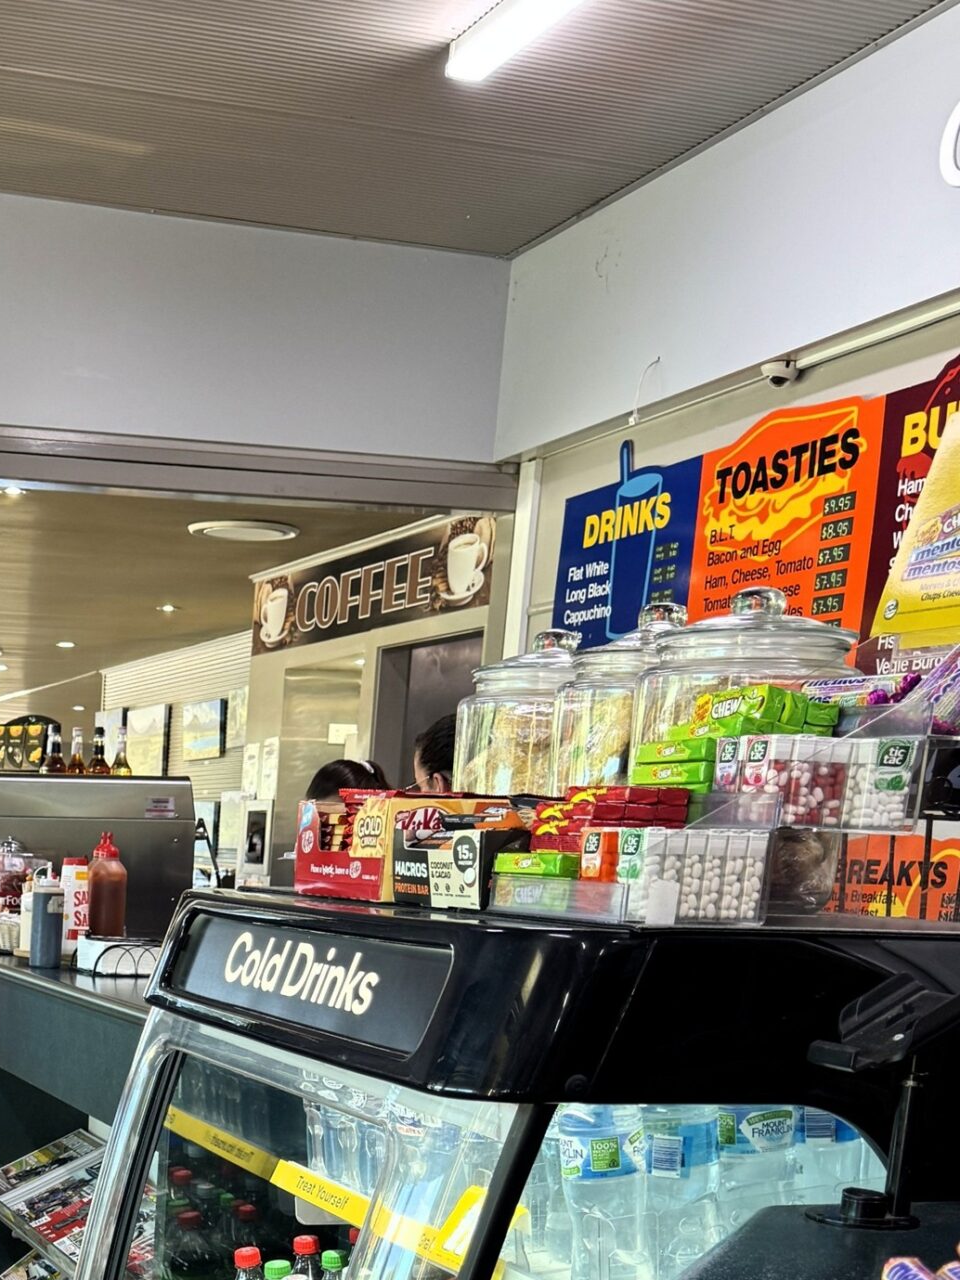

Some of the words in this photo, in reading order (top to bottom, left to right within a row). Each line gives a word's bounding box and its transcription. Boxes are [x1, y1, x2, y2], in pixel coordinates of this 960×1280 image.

[717, 428, 860, 503] TOASTIES
[824, 496, 851, 514] $9.95
[583, 492, 672, 549] DRINKS
[822, 519, 848, 539] $8.95
[707, 550, 738, 567] Bacon
[740, 545, 758, 560] and
[761, 538, 782, 557] Egg
[818, 547, 844, 566] $7.95
[568, 566, 583, 583] Flat
[585, 561, 609, 579] White
[705, 575, 728, 591] Ham,
[731, 565, 771, 584] Cheese,
[775, 556, 814, 576] Tomato
[295, 546, 435, 632] COFFEE
[815, 572, 843, 591] $7.95
[565, 588, 586, 604] Long
[588, 580, 612, 598] Black
[704, 594, 732, 612] Tomat
[812, 597, 839, 615] $7.95
[564, 604, 612, 626] Cappuchino
[711, 695, 744, 720] CHEW
[725, 742, 736, 752] tic
[754, 742, 767, 752] tic
[888, 746, 905, 757] tic
[721, 752, 734, 761] tac
[750, 752, 765, 761] tac
[883, 754, 904, 766] tac
[357, 815, 383, 837] GOLD
[584, 842, 599, 853] tac
[588, 834, 600, 844] tic
[627, 834, 639, 845] tic
[624, 844, 638, 855] tac
[395, 861, 428, 878] MACROS
[430, 861, 453, 870] COCONUT
[435, 871, 451, 879] CACAO
[395, 882, 417, 894] PROTEIN
[418, 885, 429, 895] BAR
[224, 931, 293, 992] Cold
[281, 942, 379, 1016] Drinks
[751, 1124, 793, 1138] FRANKLIN
[762, 1119, 787, 1129] MOUNT
[592, 1140, 617, 1151] 100%
[296, 1175, 316, 1195] Treat
[316, 1184, 350, 1210] Yourself
